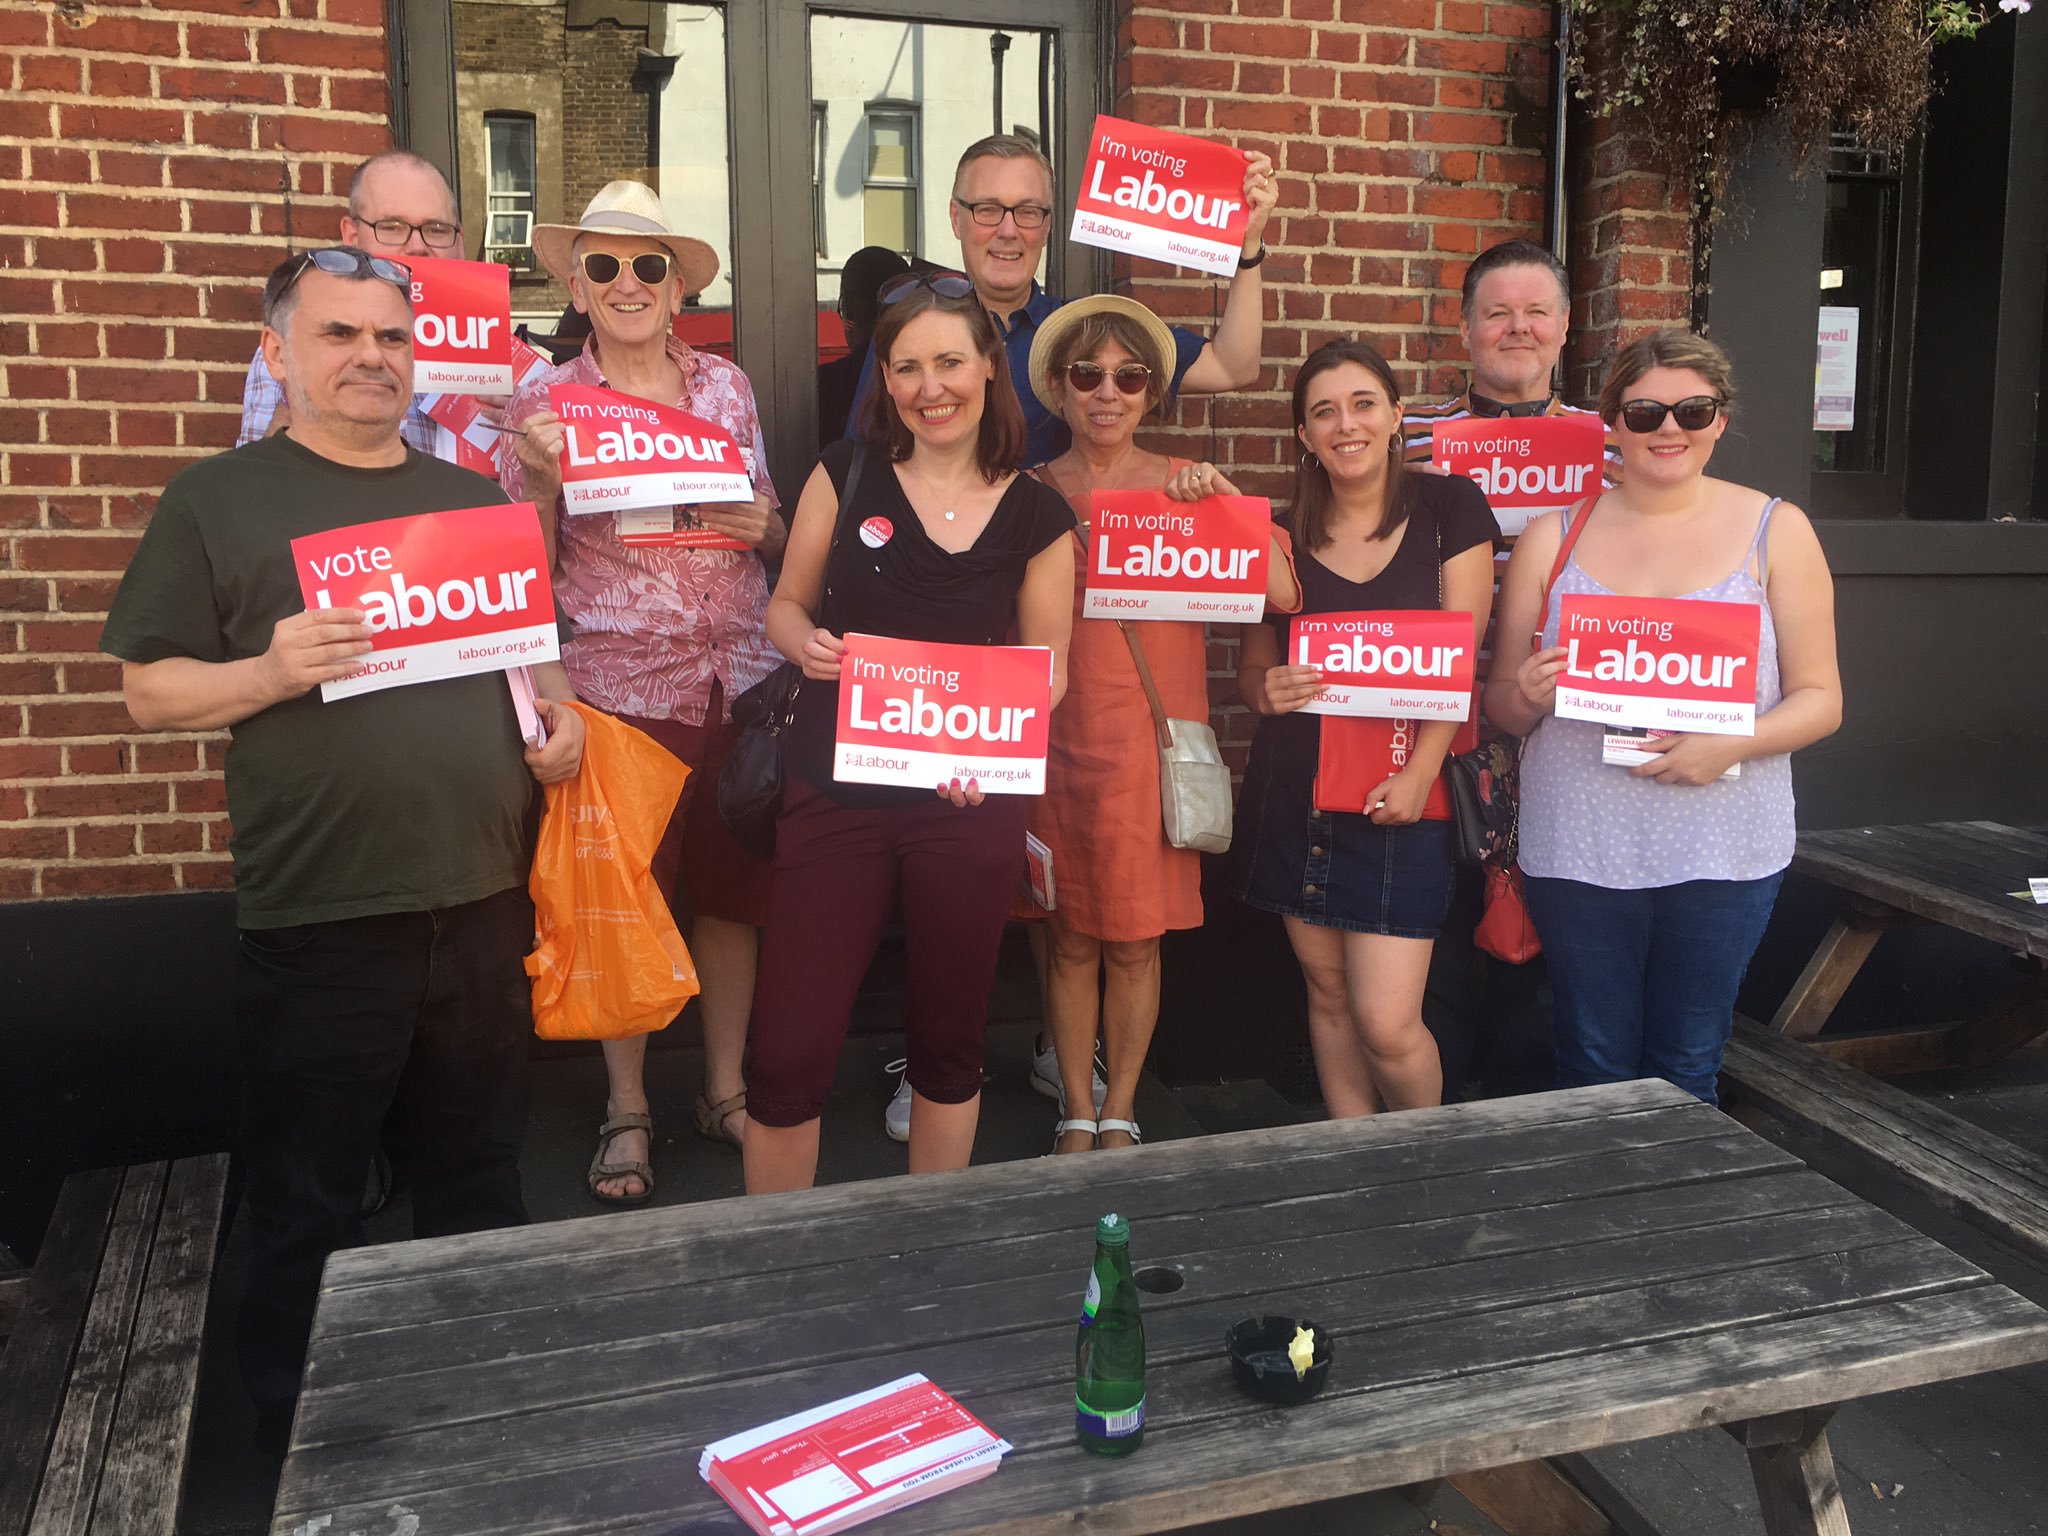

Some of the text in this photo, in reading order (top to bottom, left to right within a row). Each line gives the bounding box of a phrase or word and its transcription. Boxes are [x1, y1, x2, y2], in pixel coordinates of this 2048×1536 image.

[1100, 135, 1187, 177] I'm voting
[1088, 160, 1241, 229] Labour
[1091, 223, 1132, 240] Labour
[1168, 241, 1230, 263] labour.org.uk
[414, 313, 499, 349] our
[428, 372, 502, 384] labour.org.uk
[562, 401, 660, 425] I'm voting
[566, 422, 728, 467] Labour
[1442, 436, 1531, 457] I'm voting
[586, 485, 631, 501] Labour
[673, 481, 742, 492] labour.org.uk
[863, 520, 889, 542] Labour
[1101, 510, 1194, 537] I'm voting
[309, 545, 393, 581] vote
[1098, 535, 1260, 580] Labour
[1104, 597, 1149, 609] Labour
[1187, 601, 1254, 614] labour.org.uk
[1300, 619, 1394, 637] I'm voting
[1571, 613, 1674, 642] I'm voting
[458, 637, 546, 661] labour.org.uk
[1299, 635, 1463, 677] Labour
[1567, 639, 1747, 688] Labour
[853, 657, 960, 692] I'm voting
[1312, 690, 1351, 704] abour
[1390, 698, 1460, 711] labour.org.uk
[1576, 696, 1624, 713] Labour
[849, 684, 1036, 742] Labour
[1667, 708, 1744, 723] labour.org.uk
[1388, 719, 1408, 777] abo
[859, 754, 910, 771] Labour
[954, 765, 1032, 781] labour.org.uk
[761, 1440, 809, 1465] Thank you!
[964, 1453, 975, 1462] TO
[975, 1445, 998, 1457] WANT
[920, 1467, 944, 1480] FROM
[944, 1459, 964, 1471] HEAR
[902, 1477, 920, 1489] YOU
